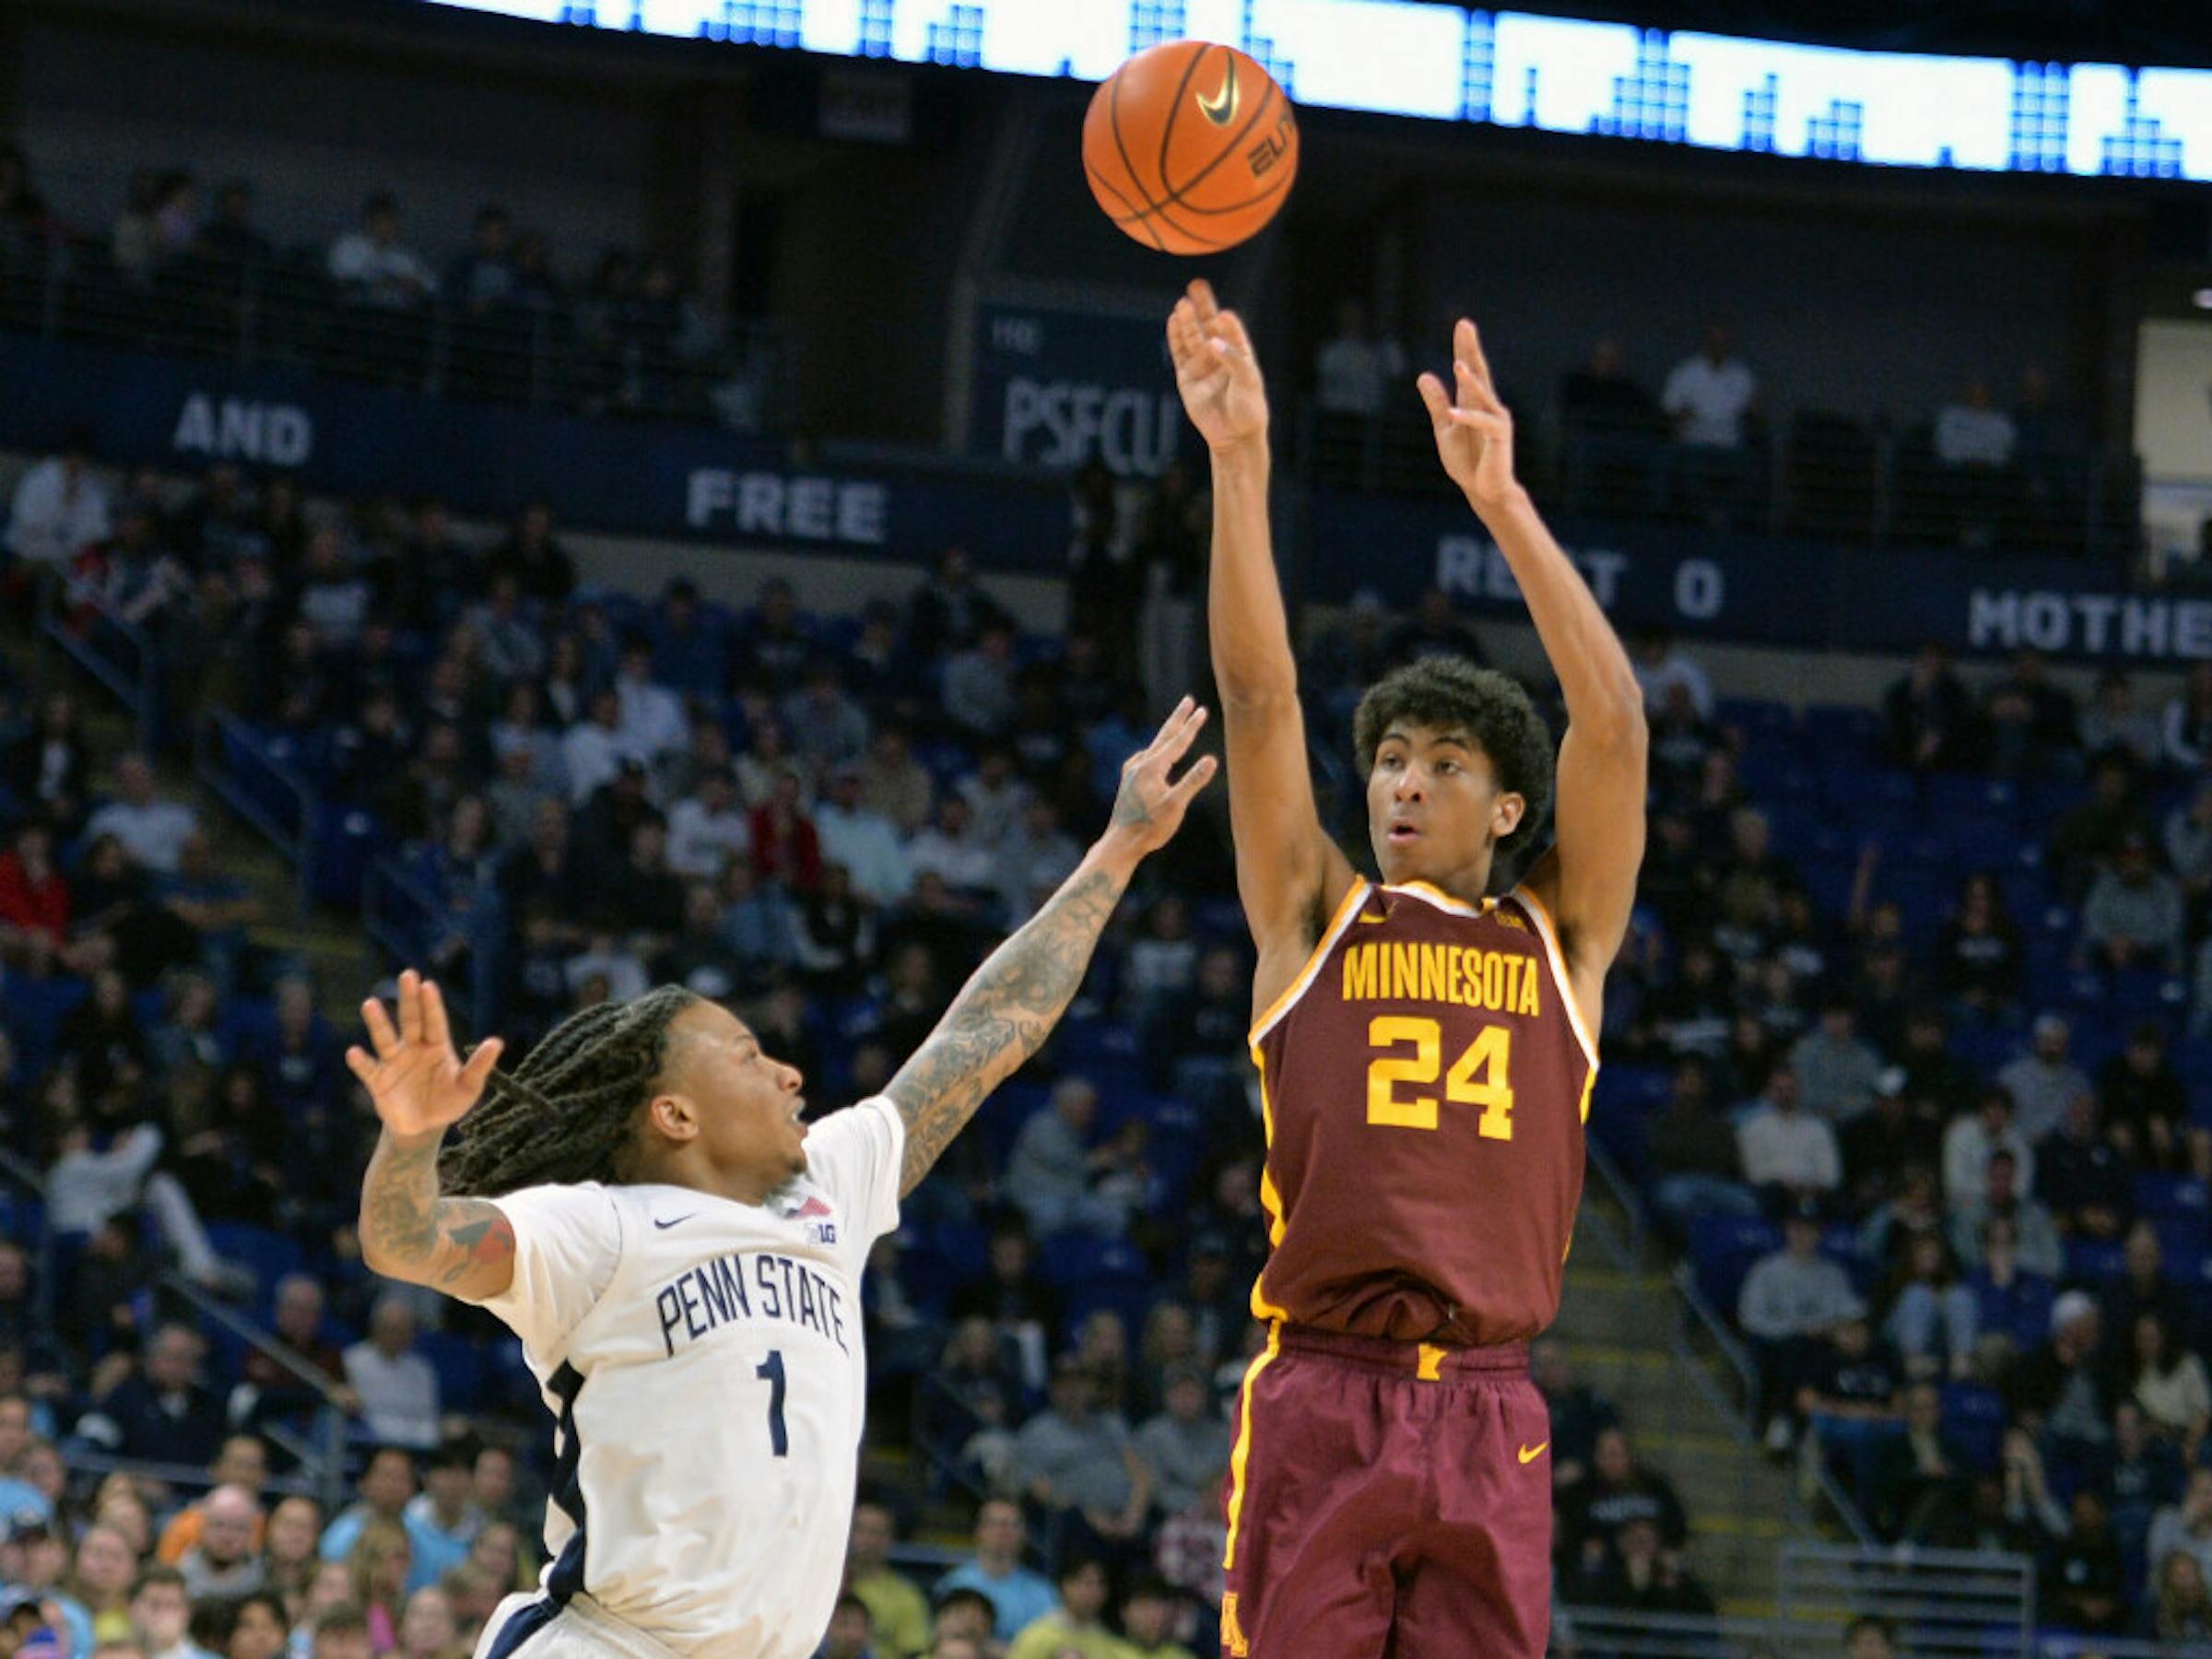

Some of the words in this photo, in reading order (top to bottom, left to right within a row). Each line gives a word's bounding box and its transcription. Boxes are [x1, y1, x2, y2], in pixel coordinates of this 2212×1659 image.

[173, 393, 313, 465] AND
[686, 467, 886, 544] FREE
[1435, 533, 1629, 610] RET
[1674, 558, 1724, 620] O
[1342, 941, 1540, 1018] MINNESOTA
[1366, 1016, 1514, 1142] 24
[656, 1252, 752, 1359] PENN
[756, 1253, 851, 1359] STATE
[756, 1349, 789, 1458] 1
